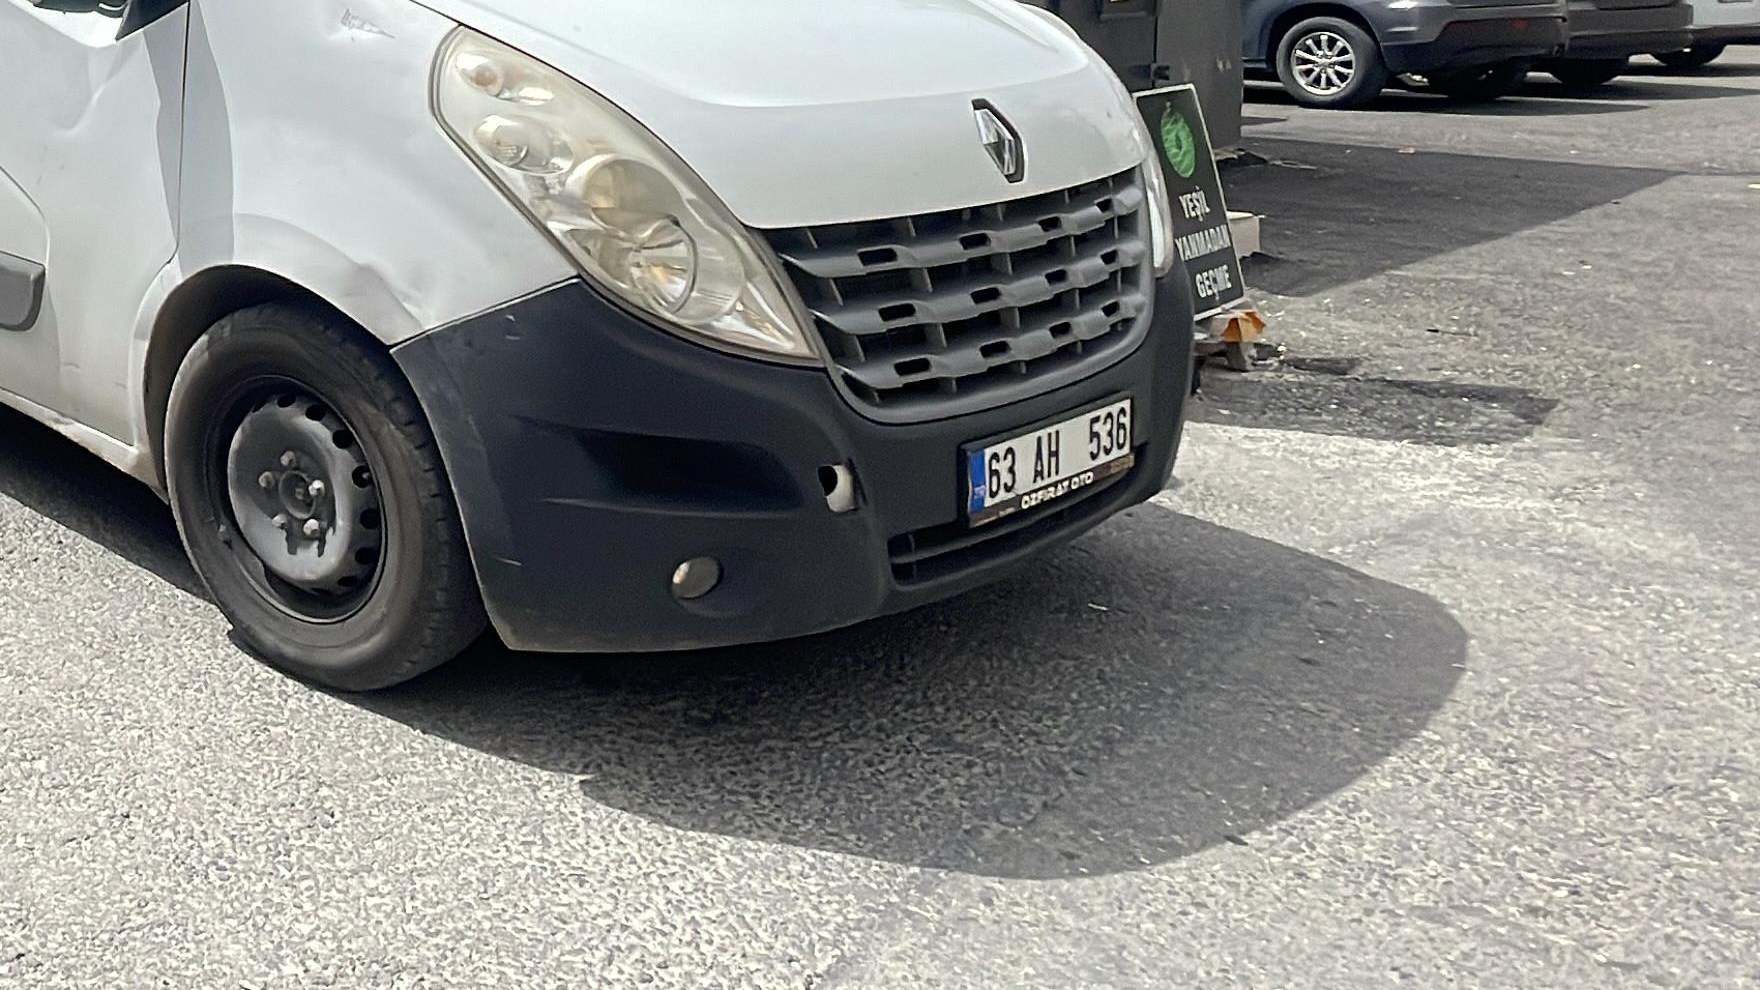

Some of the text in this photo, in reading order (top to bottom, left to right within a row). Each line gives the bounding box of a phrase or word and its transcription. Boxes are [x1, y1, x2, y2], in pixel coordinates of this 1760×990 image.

[988, 406, 1127, 499] 63 AH 536
